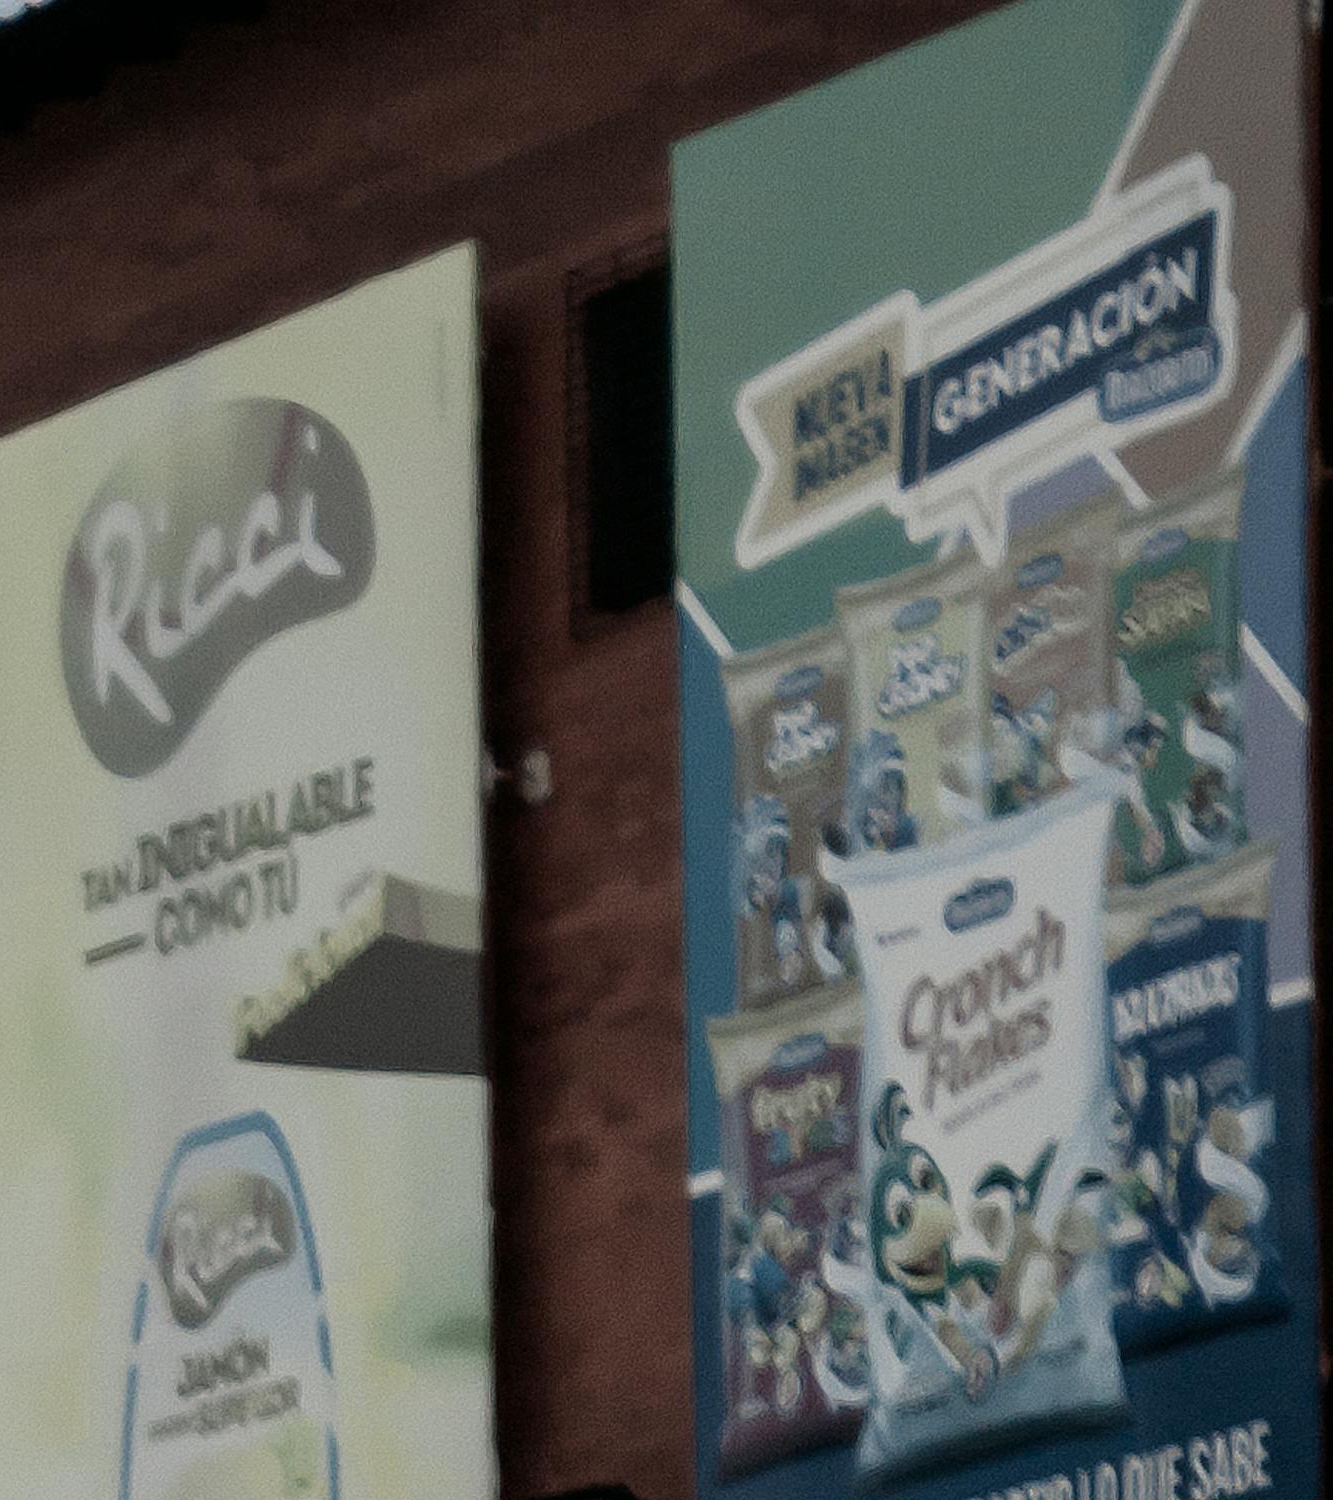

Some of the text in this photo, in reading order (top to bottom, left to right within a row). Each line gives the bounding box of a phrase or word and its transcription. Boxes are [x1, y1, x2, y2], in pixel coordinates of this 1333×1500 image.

[931, 247, 1199, 435] GENERACIÓN
[81, 757, 376, 913] TAN INIGUALABLE
[154, 879, 252, 958] COMO
